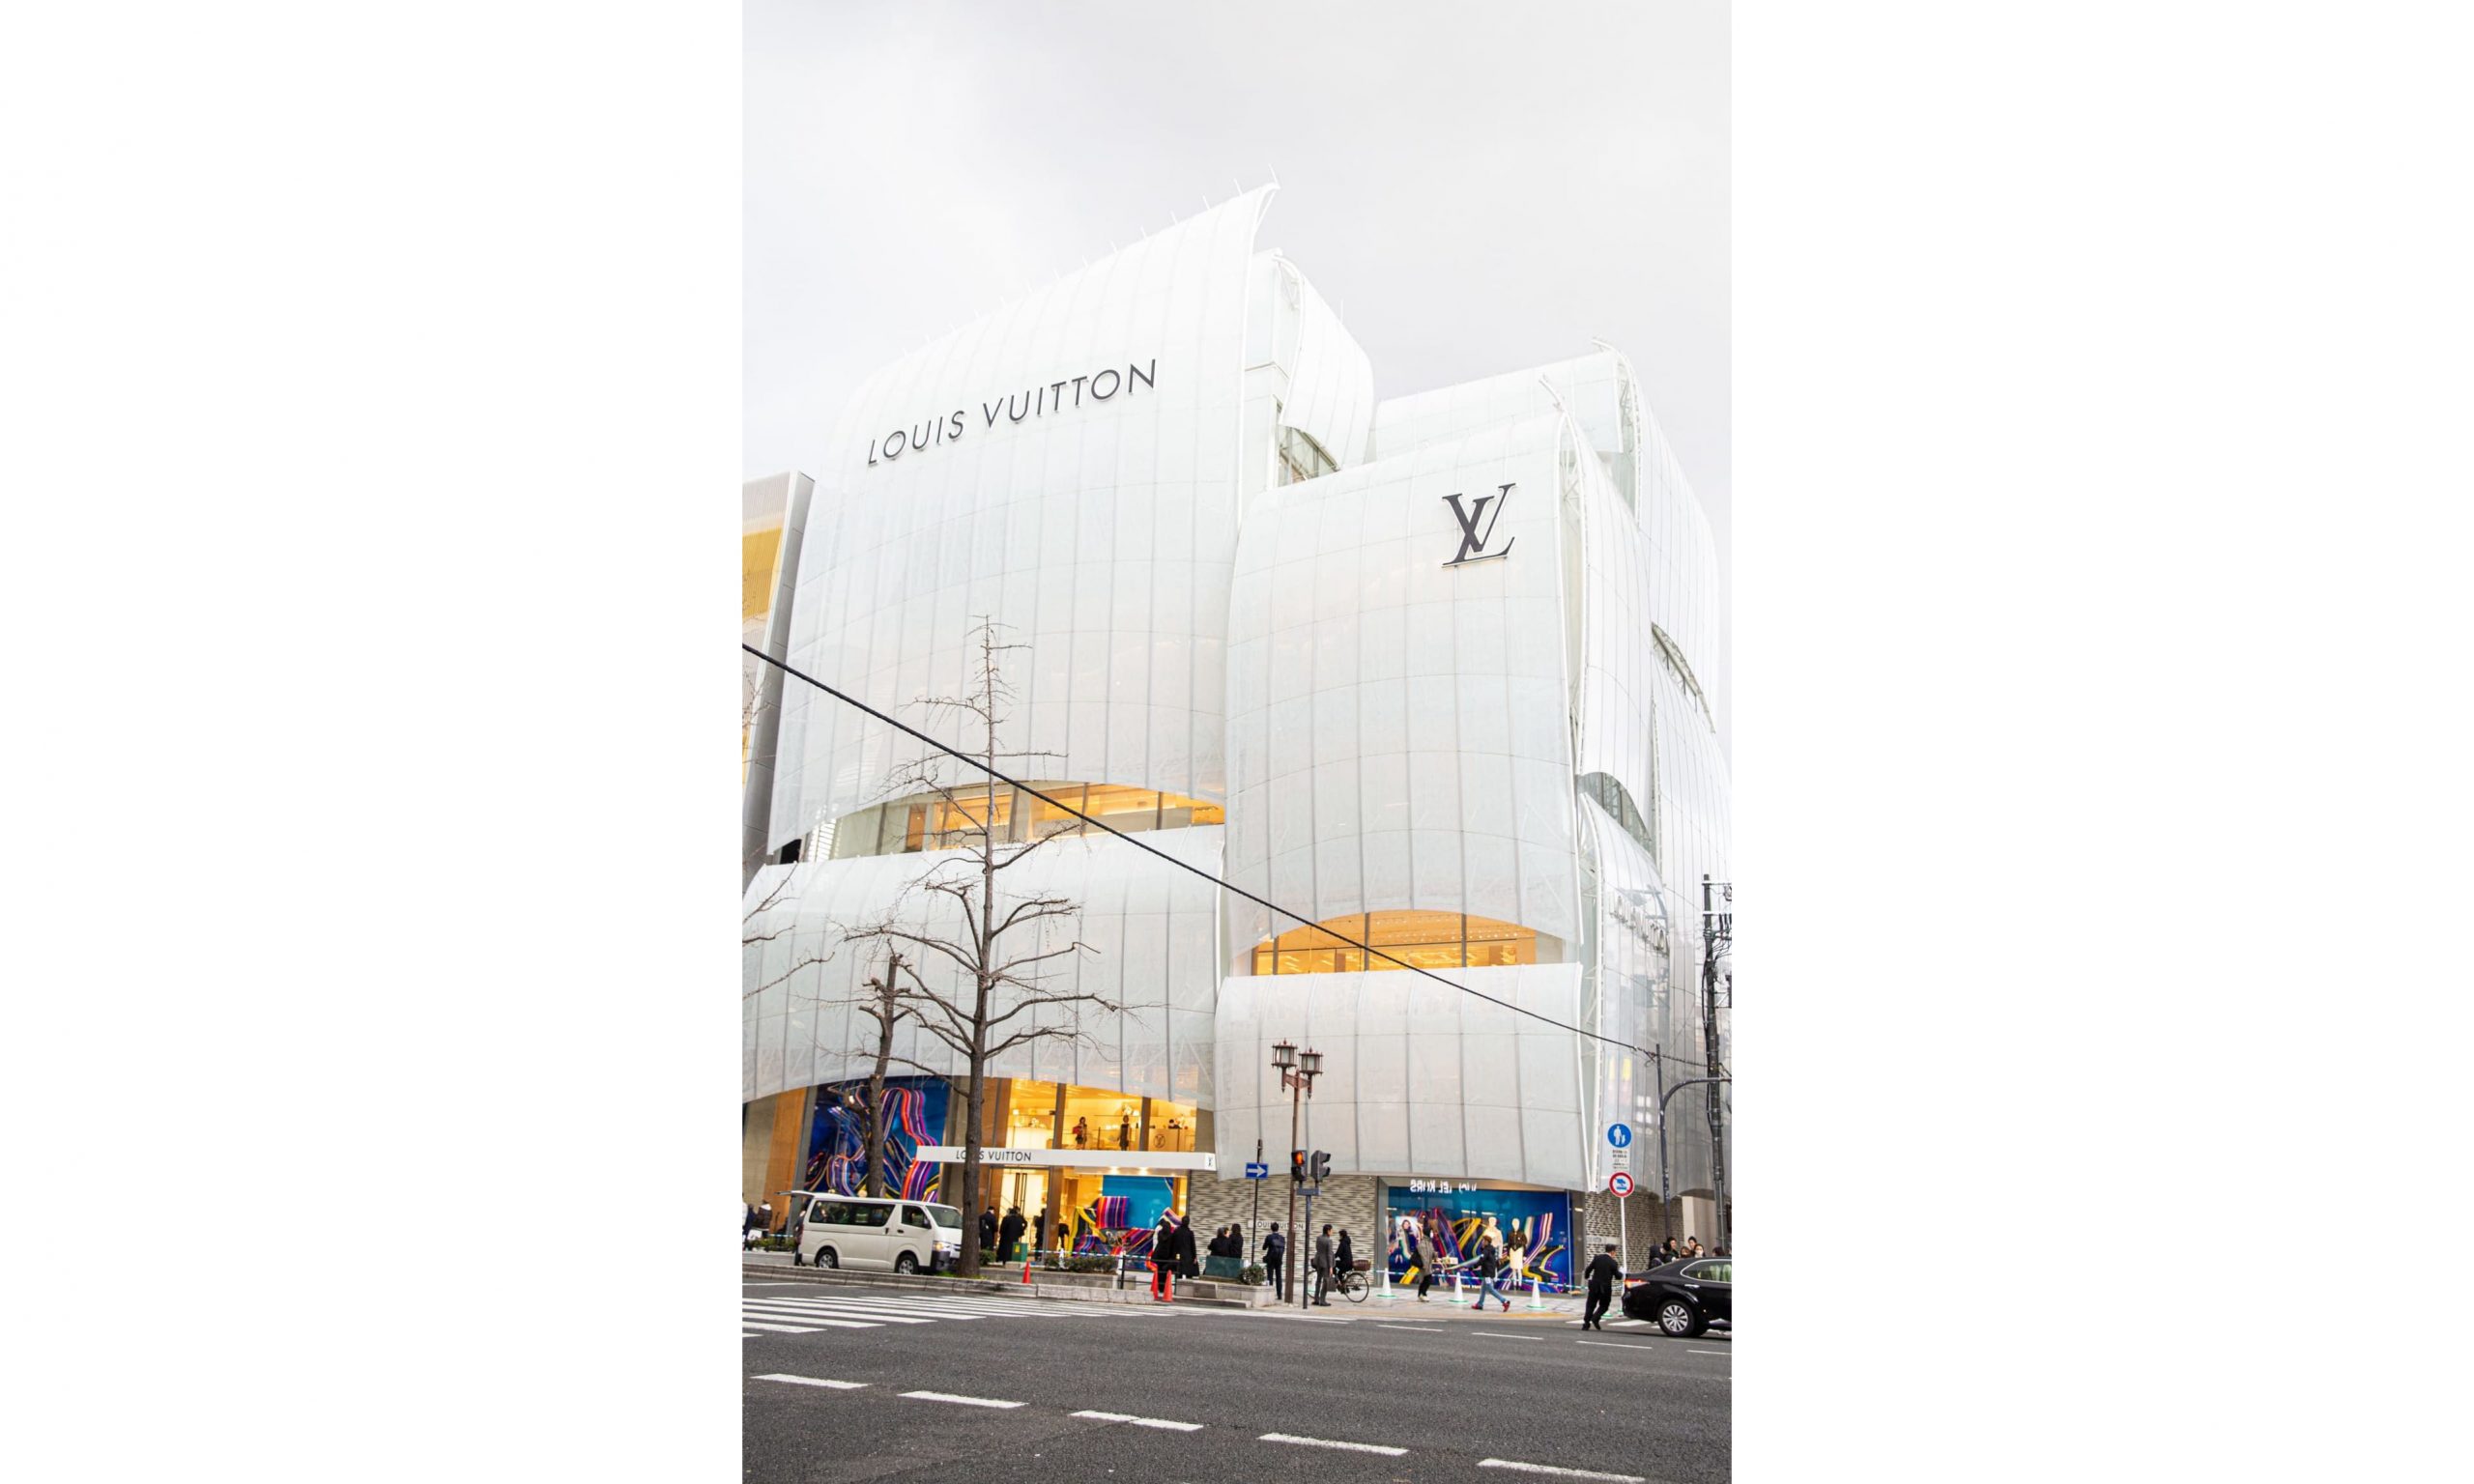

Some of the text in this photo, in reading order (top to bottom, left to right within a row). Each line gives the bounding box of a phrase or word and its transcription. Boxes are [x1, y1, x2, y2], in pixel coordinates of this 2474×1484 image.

[868, 358, 1156, 466] LOUIS VUITTON
[956, 1150, 1032, 1161] LOS VUITTON
